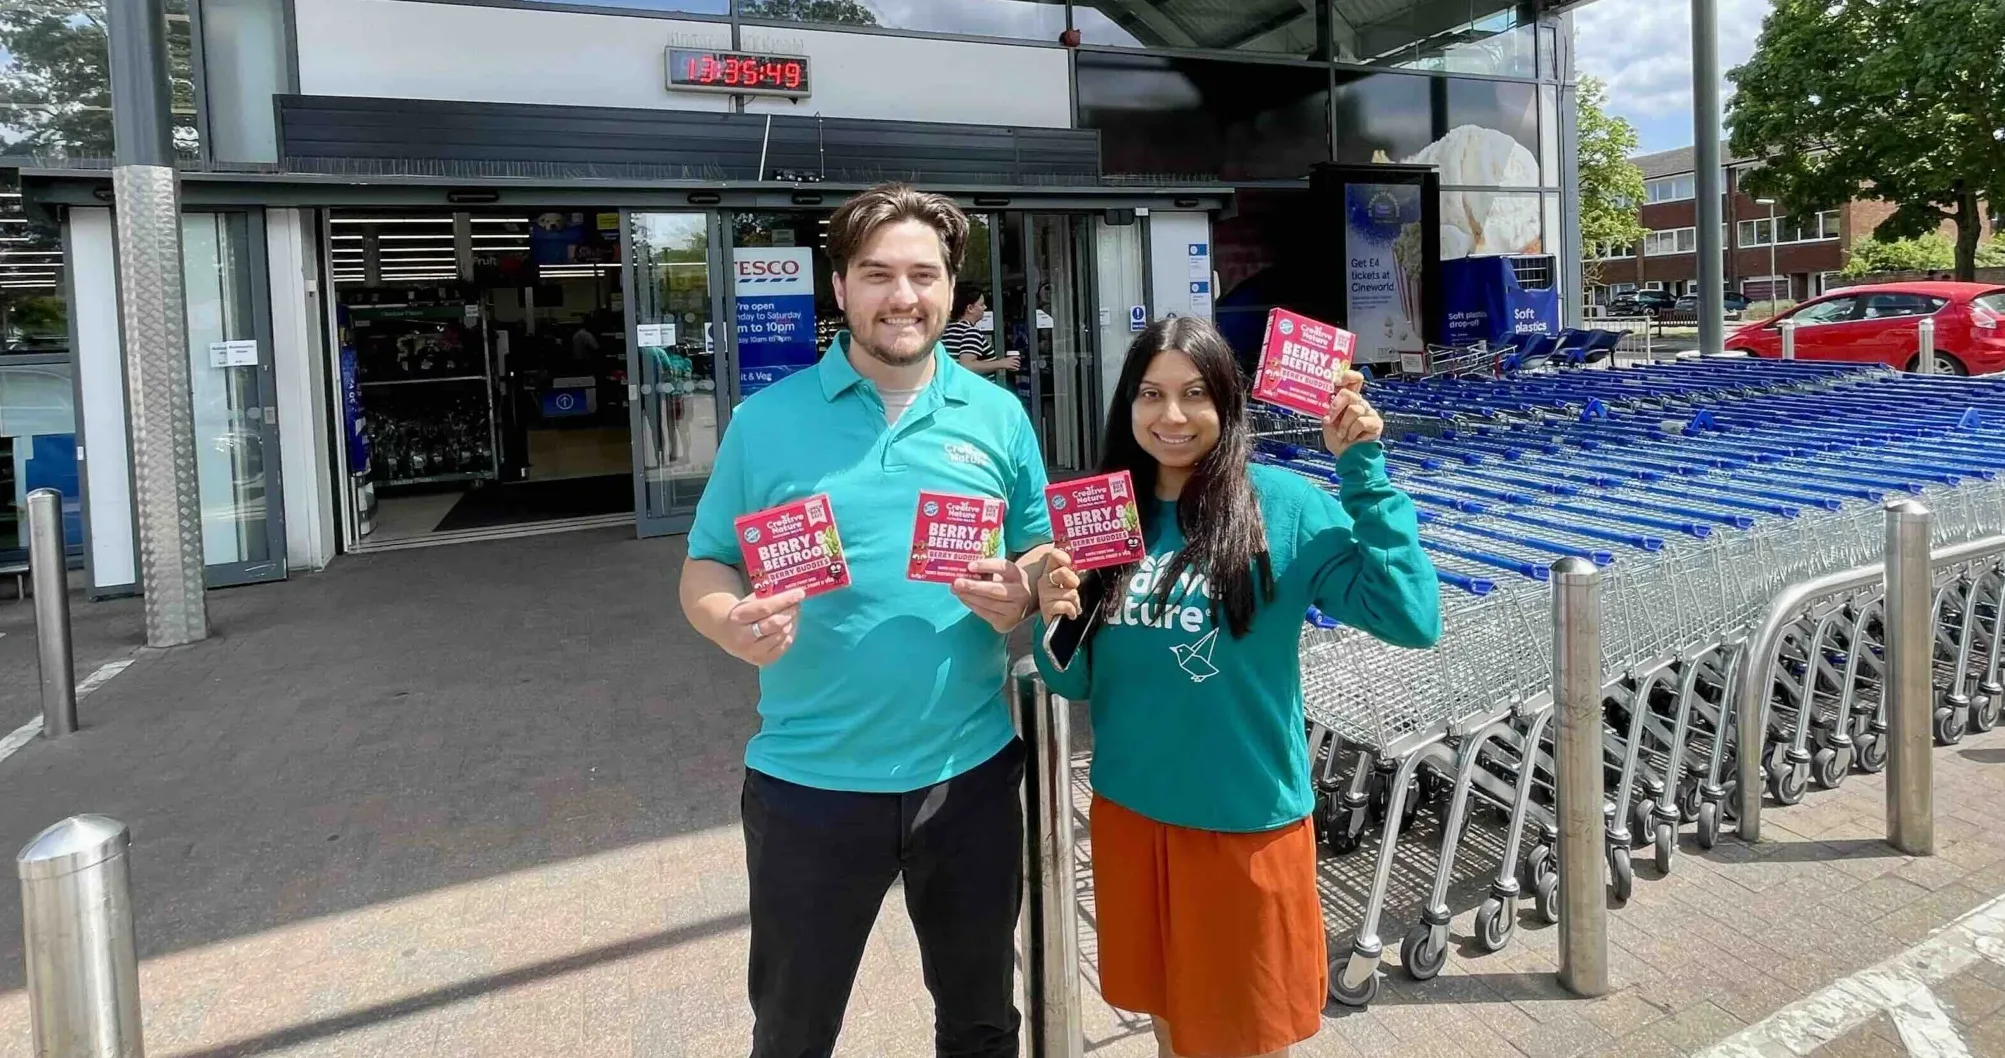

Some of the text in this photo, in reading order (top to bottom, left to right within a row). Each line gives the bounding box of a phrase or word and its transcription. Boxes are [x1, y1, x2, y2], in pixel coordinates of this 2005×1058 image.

[688, 56, 800, 88] 13:35:49
[734, 260, 799, 276] ESCO
[1351, 258, 1380, 268] Get £4
[1351, 271, 1390, 280] tickets at
[751, 303, 775, 312] open
[767, 311, 802, 320] Saturday
[1448, 311, 1464, 320] Soft
[1514, 308, 1535, 320] Soft
[750, 323, 763, 333] to
[766, 321, 795, 334] 10pm
[1449, 319, 1479, 329] drop-off
[1515, 321, 1547, 334] plastics
[1282, 340, 1330, 367] BERRY
[749, 372, 755, 381] &
[1282, 370, 1304, 380] BERRY
[1072, 487, 1107, 498] Creative
[1077, 494, 1105, 504] Nature
[946, 502, 981, 513] Creative
[948, 511, 976, 519] Nature
[1063, 504, 1125, 527] BERRY &
[766, 514, 804, 530] Creative
[1067, 518, 1131, 538] BEETROOT
[771, 522, 803, 535] Nature
[929, 522, 978, 540] BERRY
[1072, 532, 1128, 547] BERRY BUDDIES
[758, 534, 811, 561] BERRY
[929, 551, 951, 559] BERRY
[770, 559, 829, 580] BERRY BUDDIES
